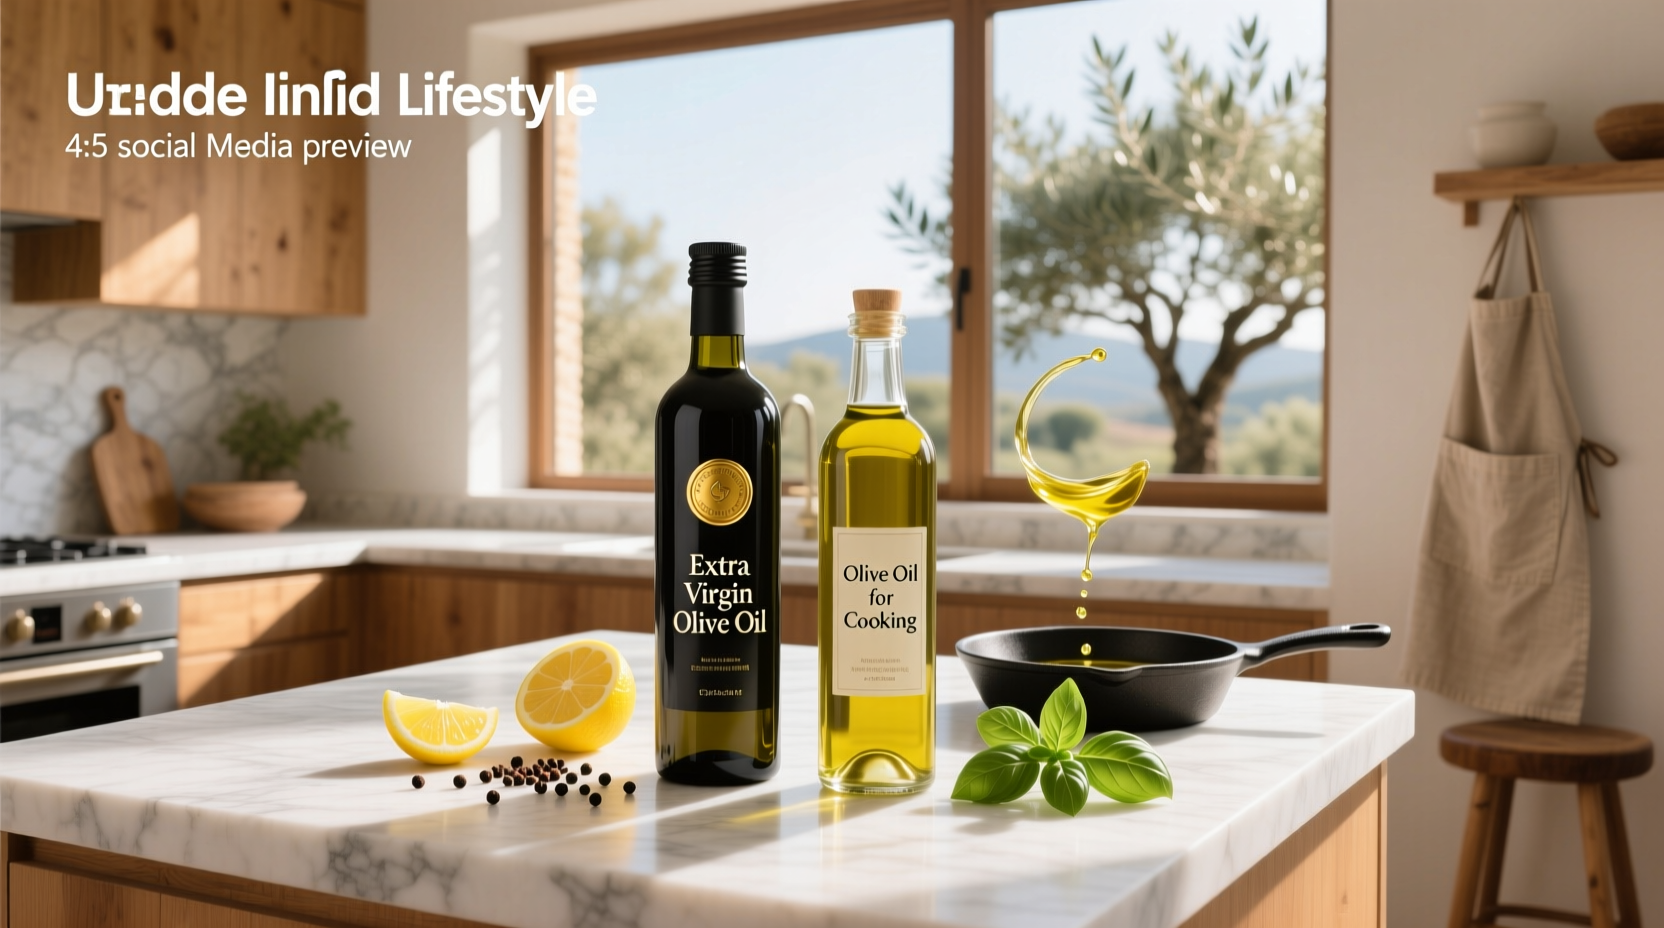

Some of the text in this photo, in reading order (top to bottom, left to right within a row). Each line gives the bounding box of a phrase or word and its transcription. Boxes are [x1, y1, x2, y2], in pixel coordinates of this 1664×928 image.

[689, 553, 751, 576] Extra
[843, 563, 918, 582] Olive Oil
[683, 582, 753, 612] Virgin
[868, 587, 894, 606] for
[673, 609, 767, 635] Olive Oil
[843, 610, 917, 634] Cooking
